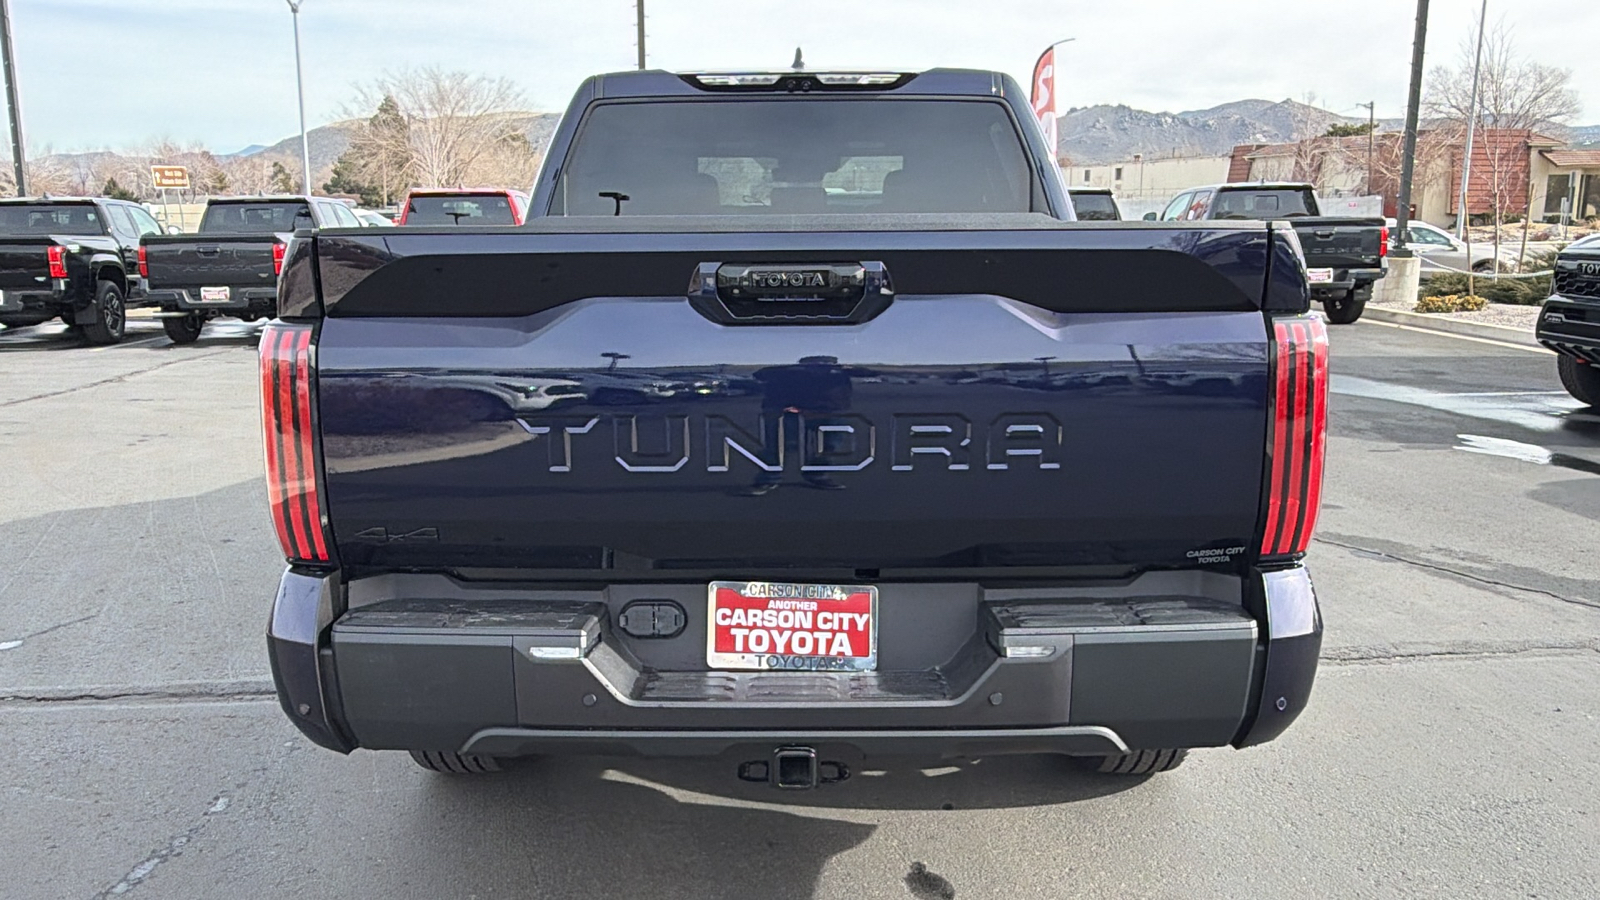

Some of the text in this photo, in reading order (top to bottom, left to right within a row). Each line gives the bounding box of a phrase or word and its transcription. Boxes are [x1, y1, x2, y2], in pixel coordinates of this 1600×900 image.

[757, 271, 825, 287] TOYOTA
[515, 412, 1063, 472] TUNDRA
[1186, 546, 1246, 558] CARSON CITY
[1197, 555, 1231, 564] TOYOTA
[749, 583, 837, 599] CARSON CITY
[768, 599, 818, 611] ANOTHER
[715, 608, 870, 632] CARSON CITY
[730, 628, 853, 657] TOYOTA
[754, 654, 829, 669] TOYOTA
